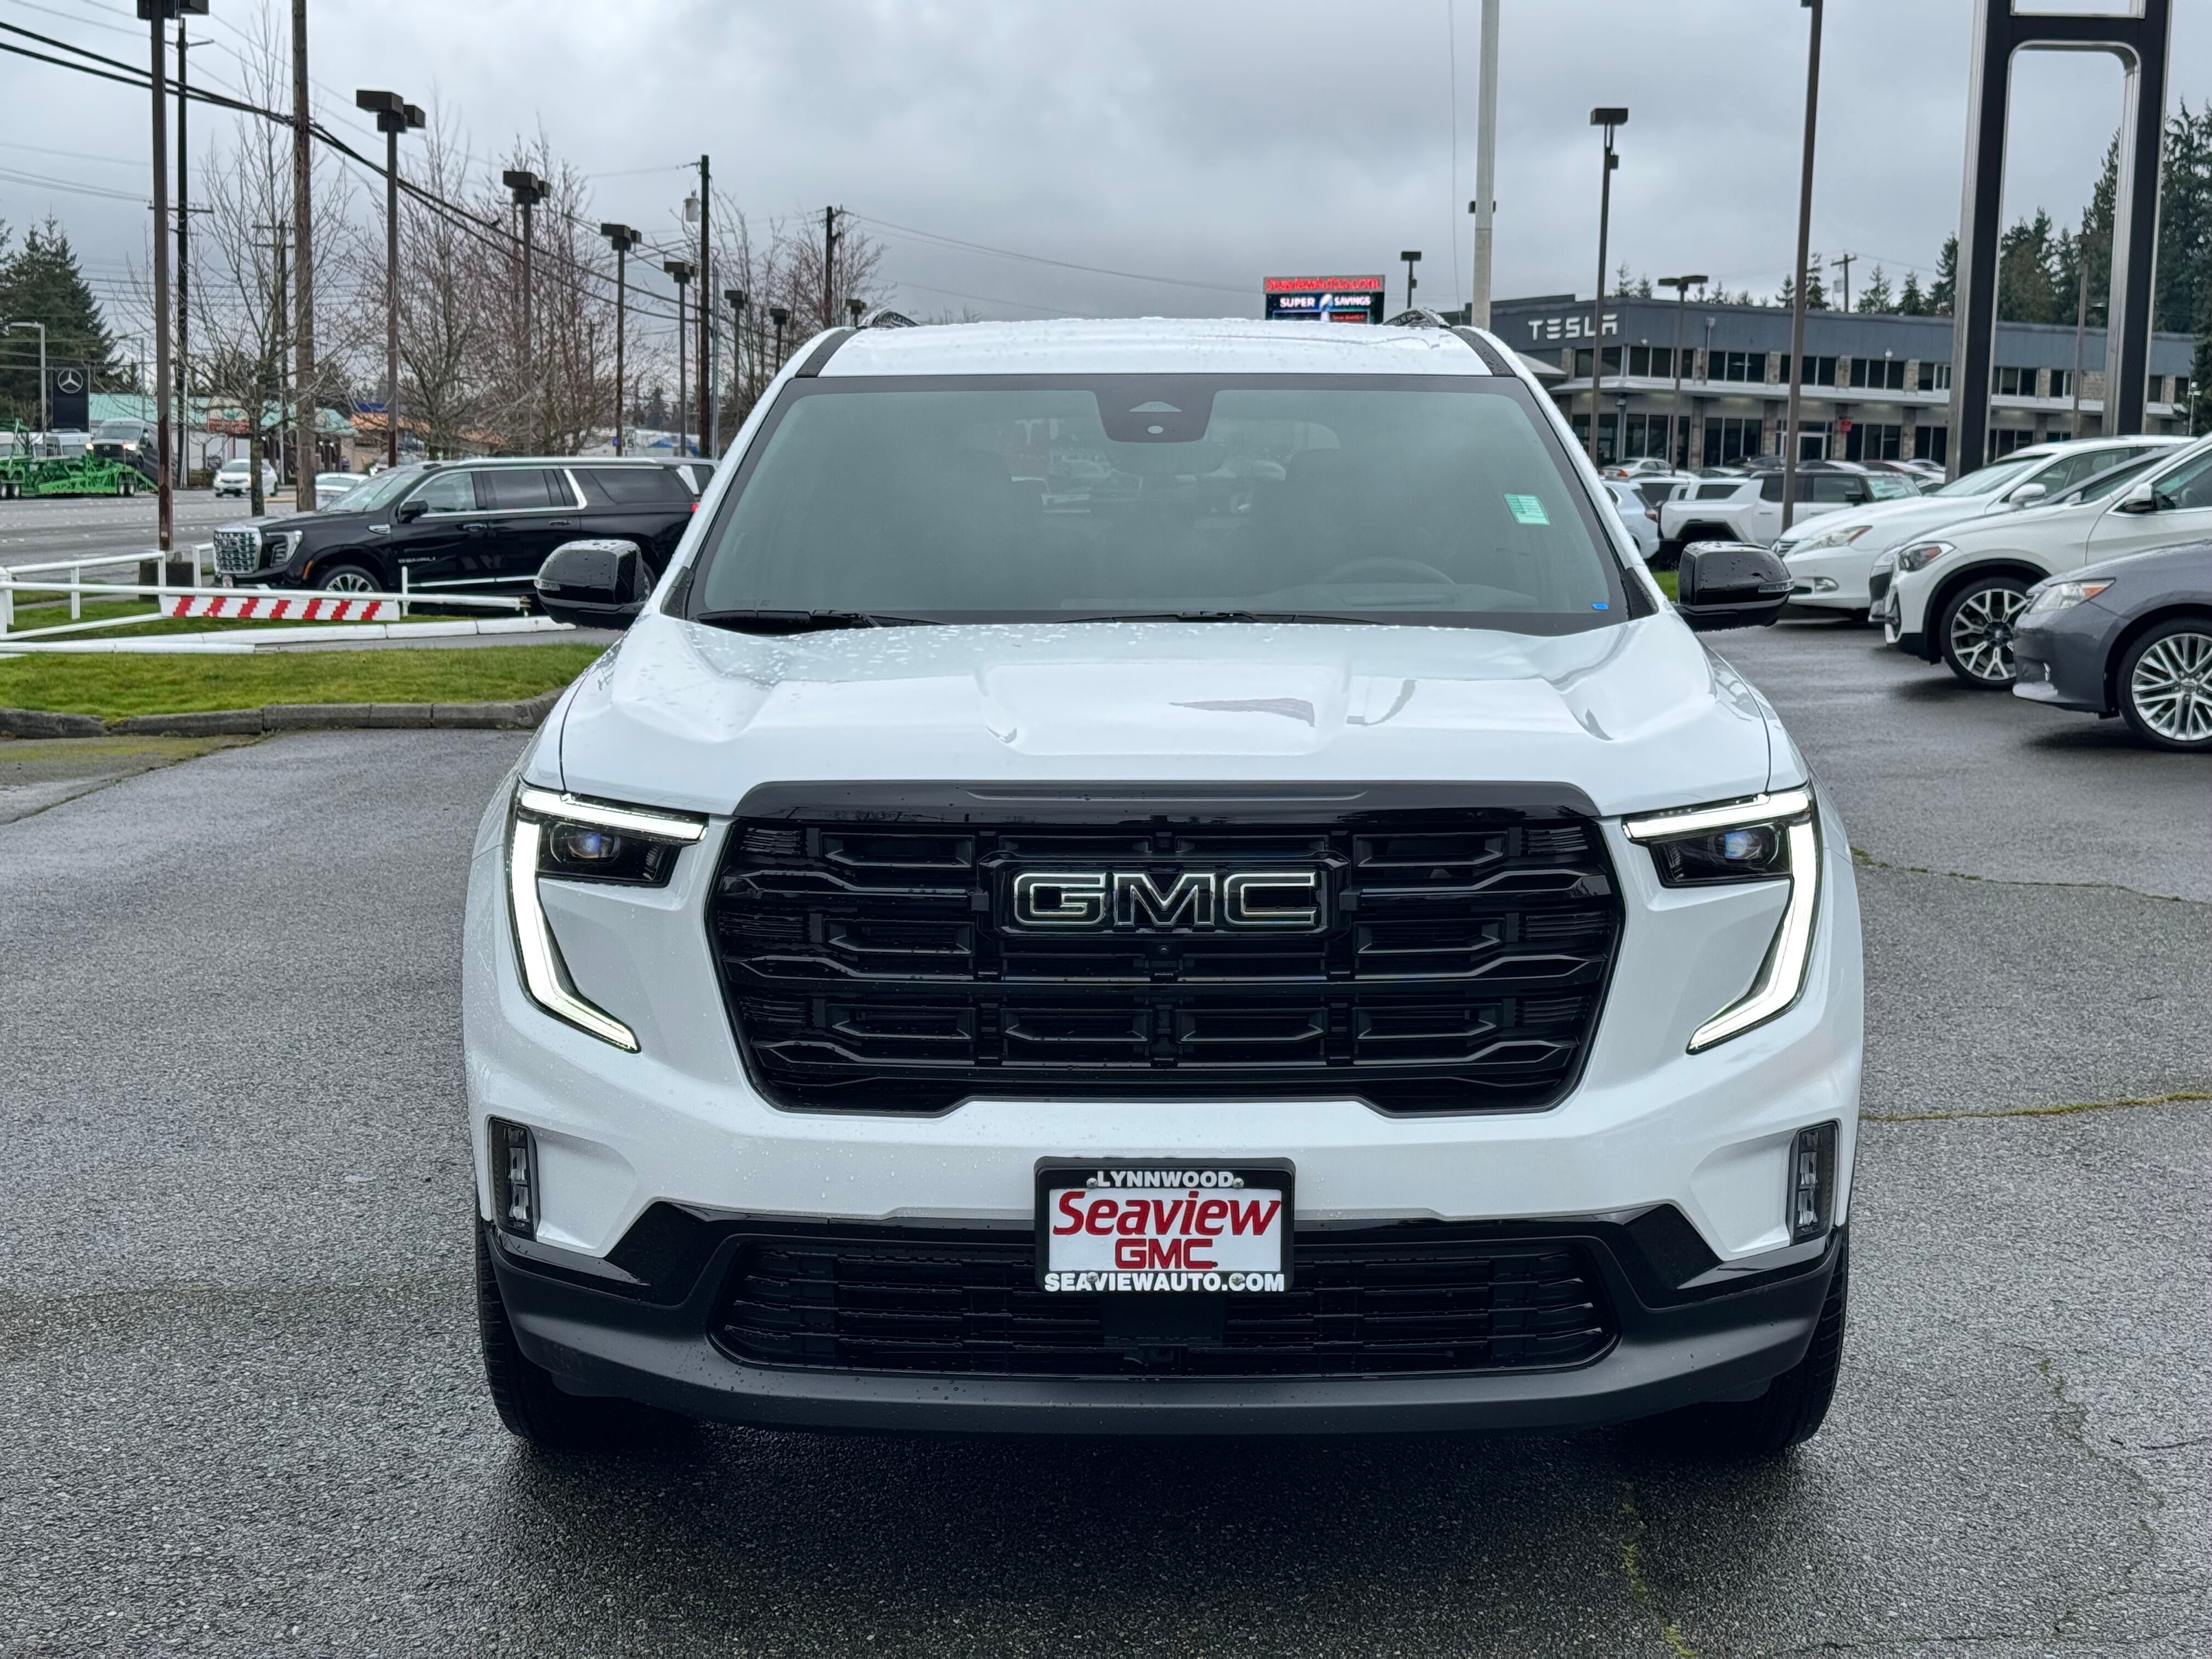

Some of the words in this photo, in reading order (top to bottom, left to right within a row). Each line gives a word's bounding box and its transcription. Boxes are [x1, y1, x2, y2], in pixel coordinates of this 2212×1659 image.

[1280, 297, 1315, 307] SUPER
[1334, 296, 1370, 306] SAVINGS
[1528, 313, 1618, 341] TESLA
[1014, 872, 1317, 926] GMC
[1097, 1171, 1234, 1188] LYNNWOOD
[1052, 1190, 1282, 1235] Seaview
[1115, 1238, 1214, 1269] GMC
[1044, 1273, 1285, 1293] SEAVIEWAUTO.COM
